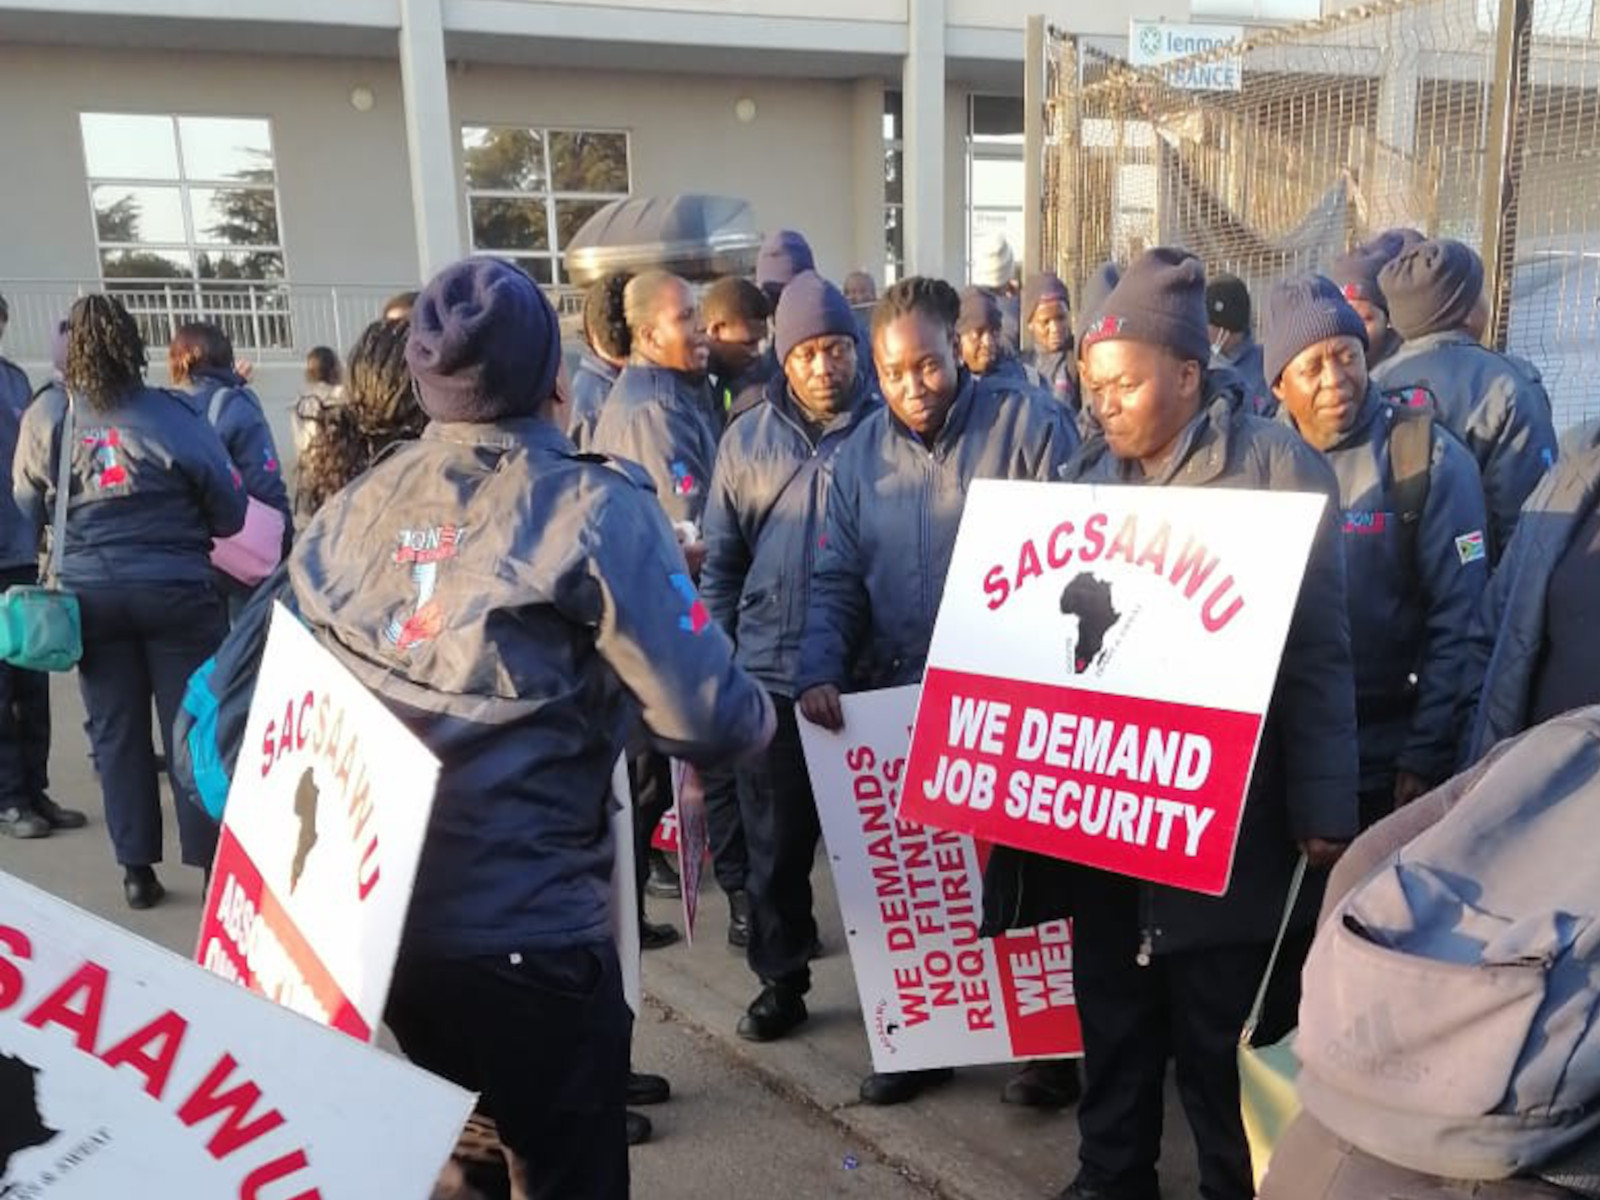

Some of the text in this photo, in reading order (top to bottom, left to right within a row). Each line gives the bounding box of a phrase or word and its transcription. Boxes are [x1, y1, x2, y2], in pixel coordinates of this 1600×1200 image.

[982, 512, 1245, 634] SACSAAWU
[946, 695, 1212, 792] WE DEMAND
[261, 690, 380, 901] SACSAAWU
[922, 755, 1215, 858] JOB SECURITY
[846, 745, 931, 1028] WE DEMANDS
[923, 949, 959, 1009] NO
[1009, 950, 1049, 1018] WE
[1037, 916, 1076, 1007] MED
